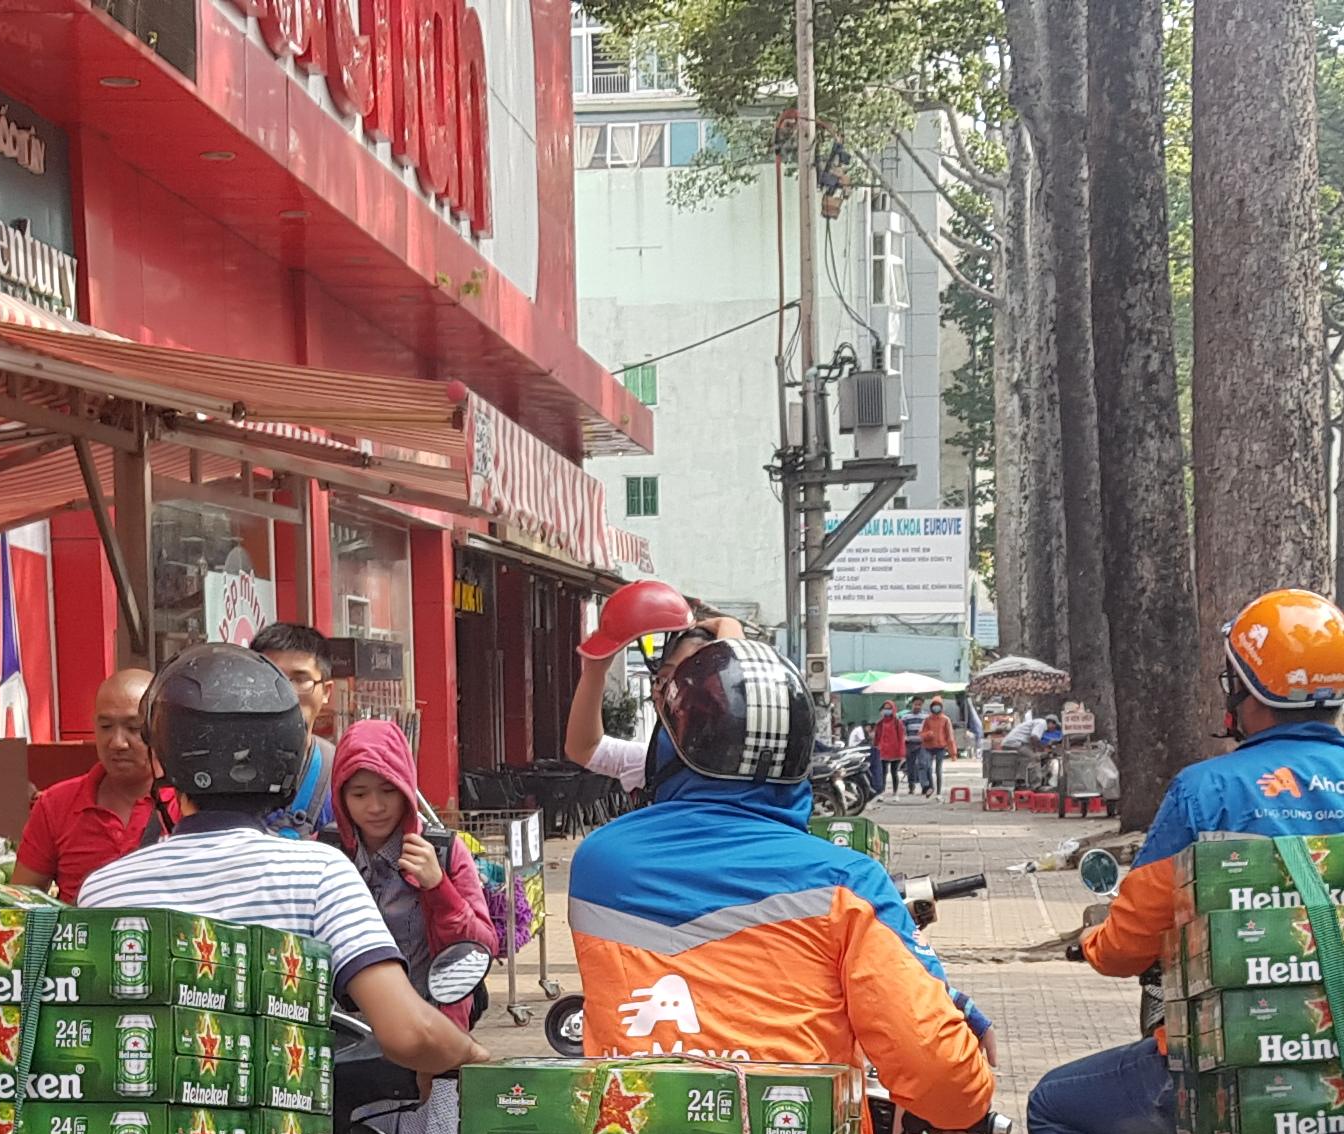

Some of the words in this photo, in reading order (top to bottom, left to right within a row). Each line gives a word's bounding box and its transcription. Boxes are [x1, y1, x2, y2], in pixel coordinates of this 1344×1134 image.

[882, 518, 894, 536] ĐA
[896, 518, 922, 536] KHOA
[923, 517, 962, 536] EUROVIE
[1314, 809, 1344, 820] GIAO
[178, 983, 227, 1010] Heineken
[267, 994, 310, 1022] Heineken
[56, 1019, 78, 1039] 24
[182, 1080, 230, 1107] Heineken
[271, 1086, 313, 1110] Heineken
[687, 1089, 715, 1110] 24
[687, 1111, 714, 1122] PACK
